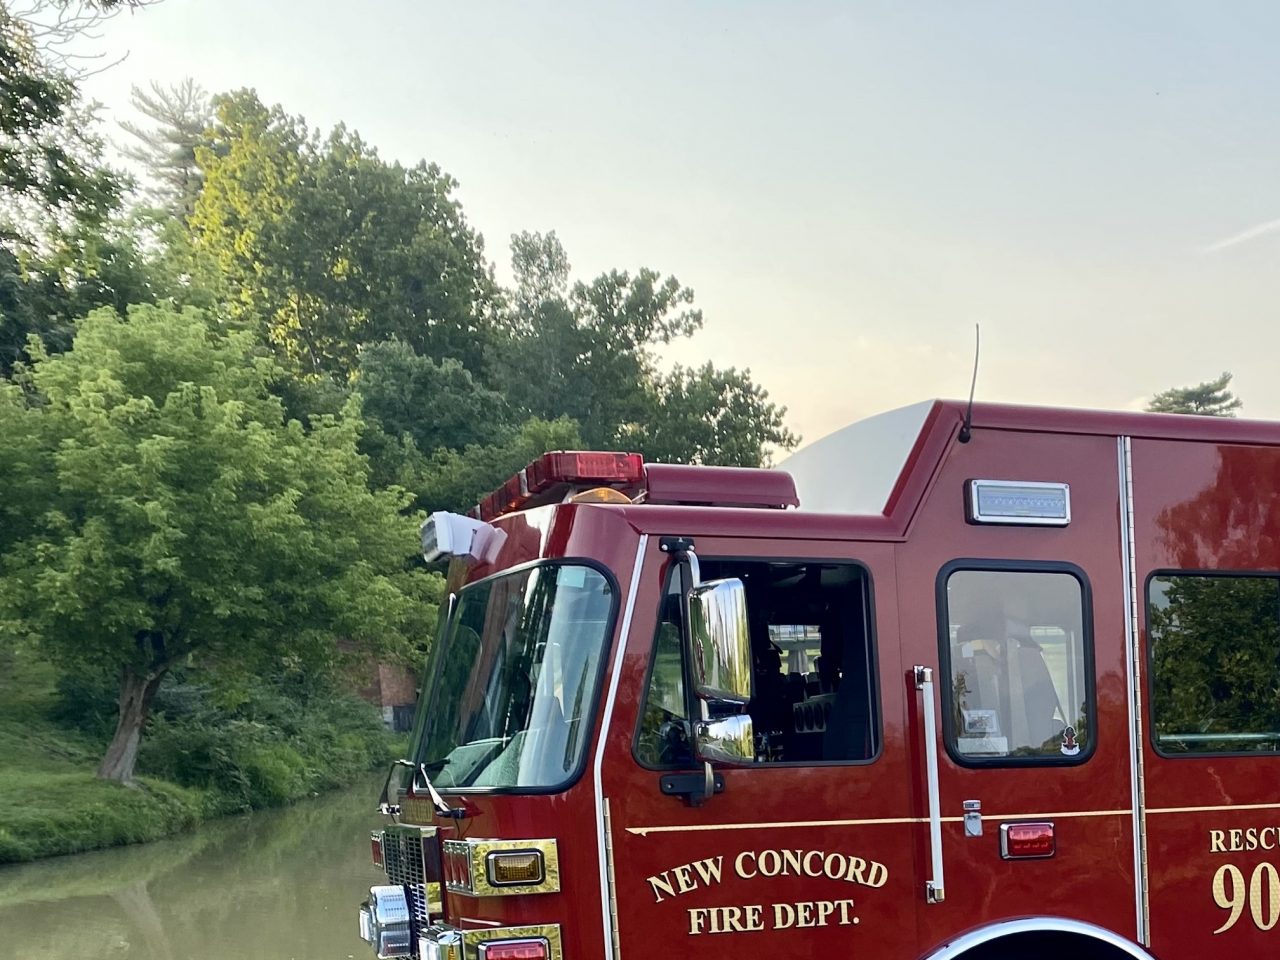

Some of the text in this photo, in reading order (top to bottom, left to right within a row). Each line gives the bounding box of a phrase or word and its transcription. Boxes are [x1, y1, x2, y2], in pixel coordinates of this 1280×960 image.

[647, 849, 889, 903] NEW CONCORD
[687, 899, 861, 936] FIRE DEPT.
